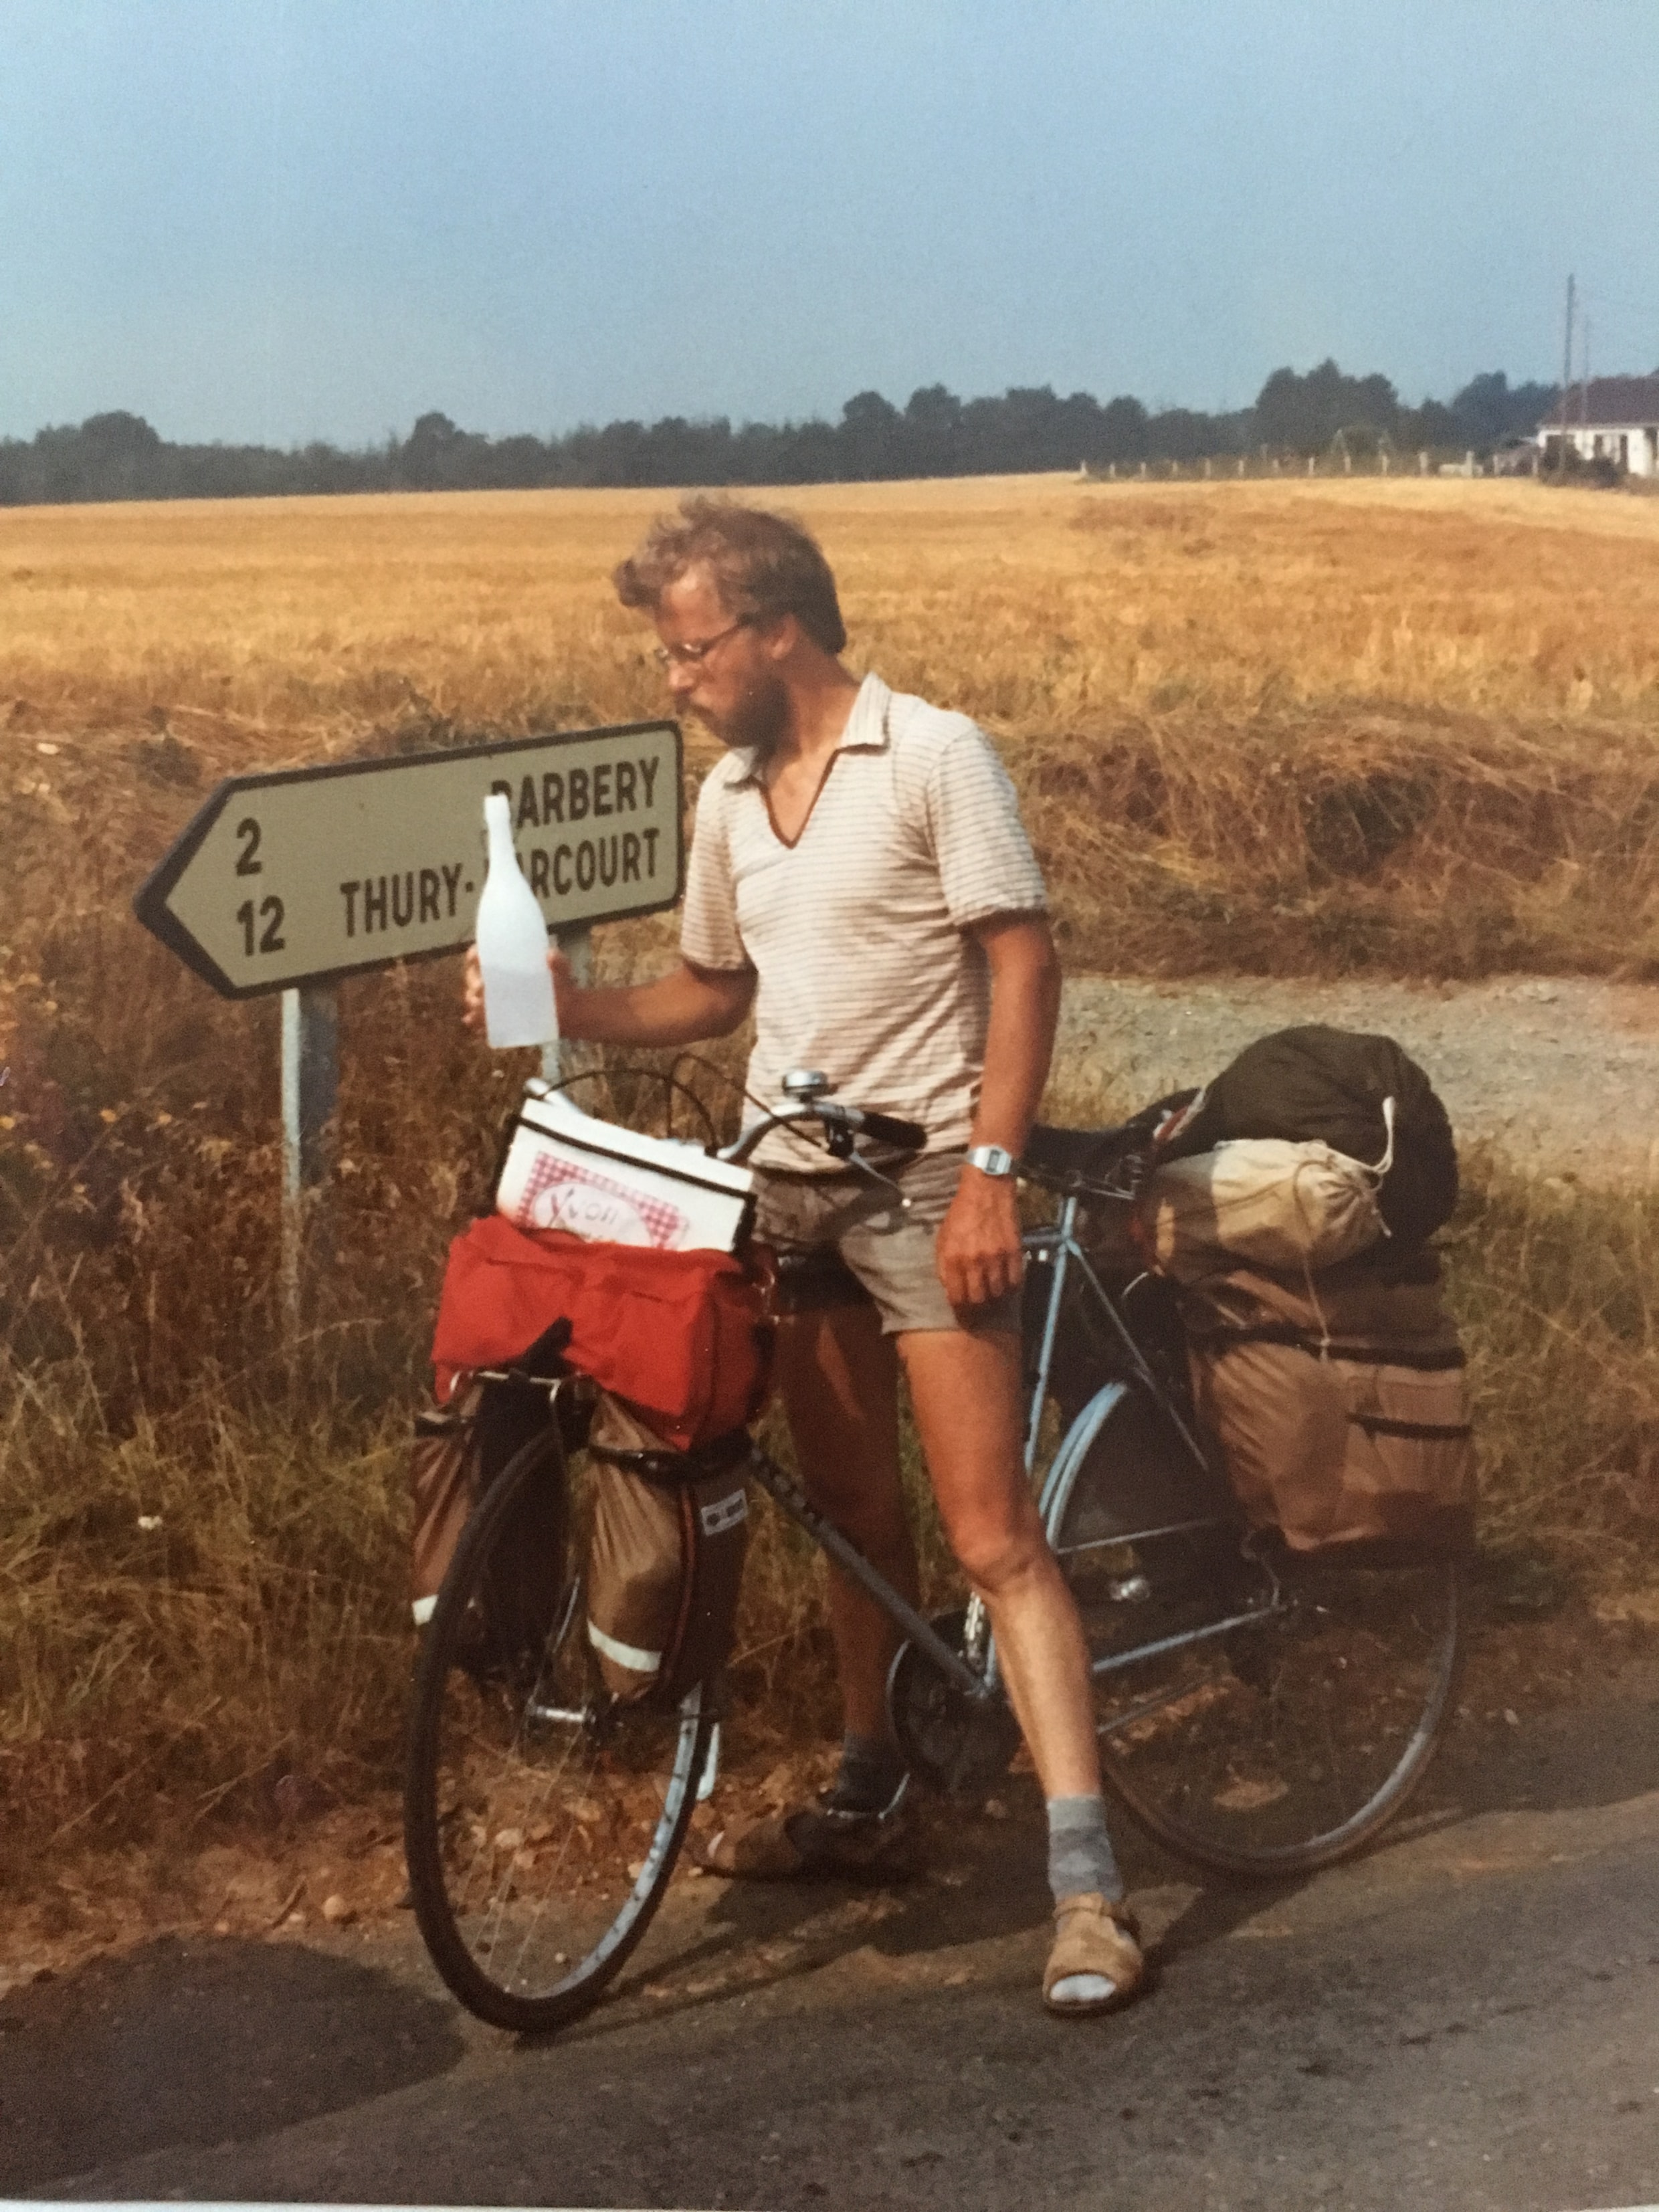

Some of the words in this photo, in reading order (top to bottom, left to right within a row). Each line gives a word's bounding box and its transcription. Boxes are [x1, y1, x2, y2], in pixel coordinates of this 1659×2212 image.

[235, 817, 262, 876] 2
[237, 895, 286, 957] 12
[340, 827, 660, 937] THURY-RCOURT
